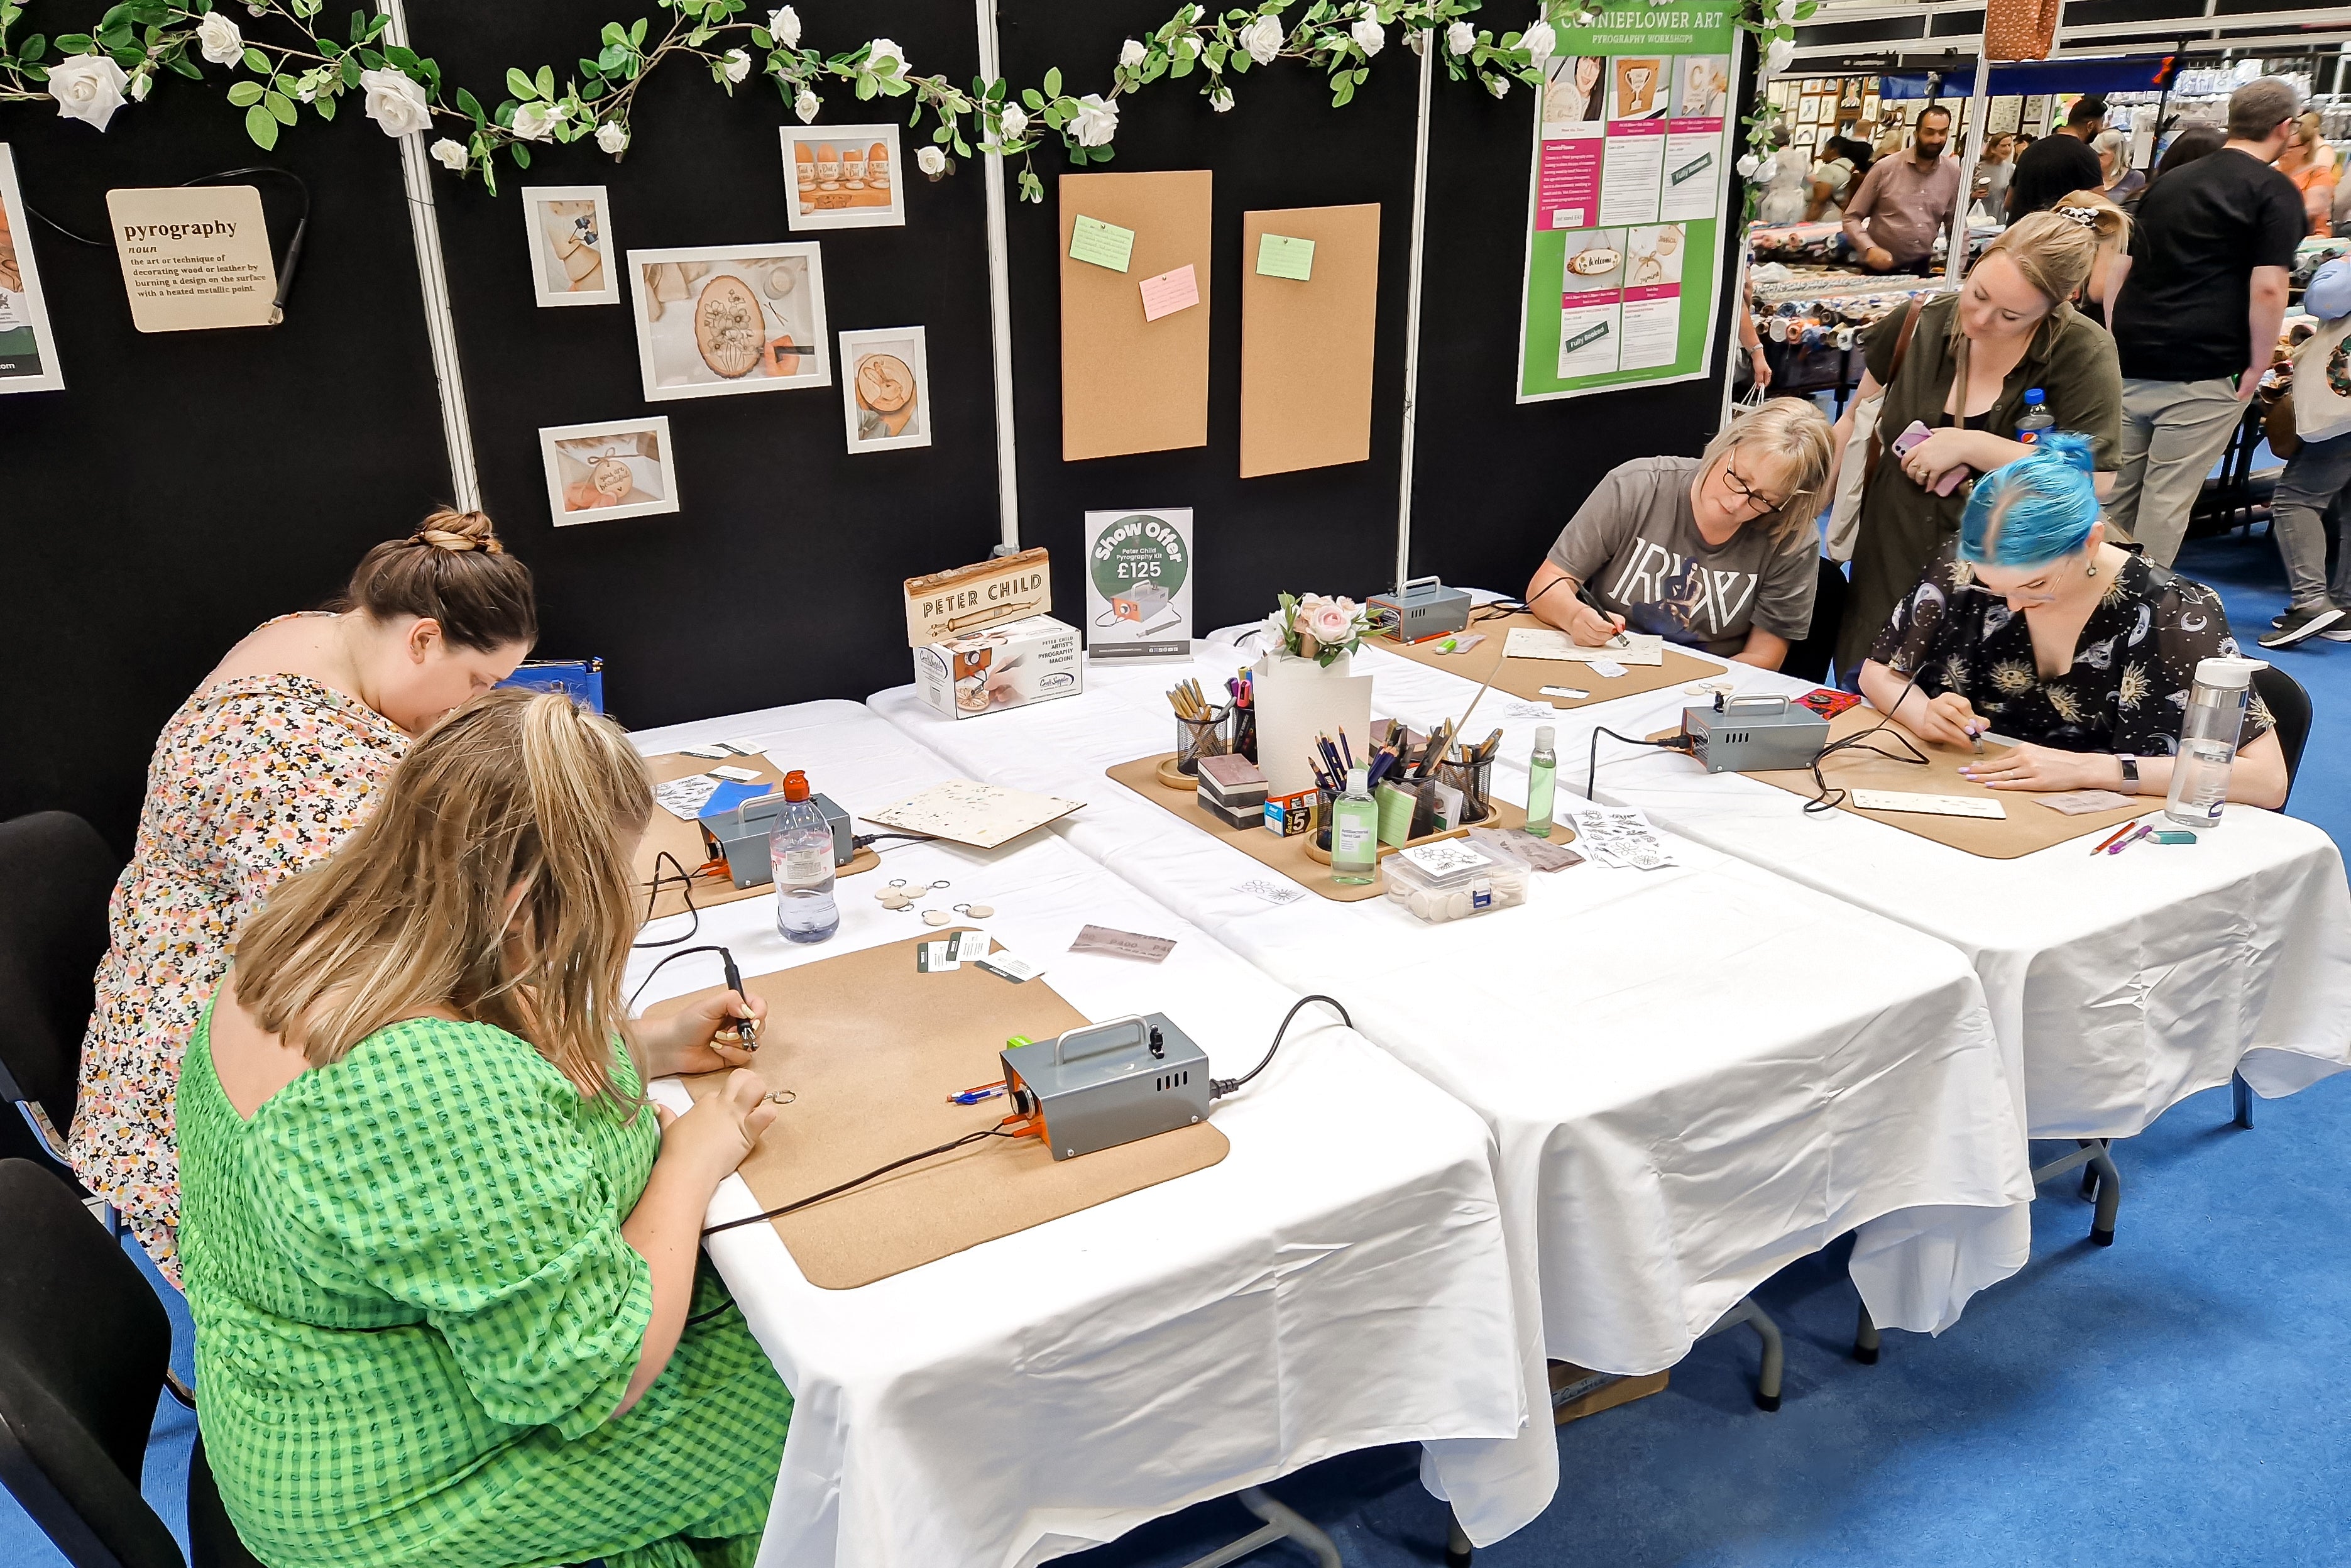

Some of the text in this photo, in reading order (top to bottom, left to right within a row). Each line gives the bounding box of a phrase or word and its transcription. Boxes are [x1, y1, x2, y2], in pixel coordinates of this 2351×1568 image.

[1694, 11, 1724, 29] ART
[1592, 33, 1694, 44] PYROGRAPHY WORKSHOPS
[124, 220, 237, 241] pyrography
[128, 246, 157, 254] noun
[173, 255, 215, 265] technique
[217, 254, 226, 262] of
[1588, 256, 1612, 267] Welcome
[133, 268, 180, 277] decorating
[181, 266, 204, 274] wood
[217, 264, 246, 272] leather
[248, 264, 258, 272] by
[135, 279, 171, 287] burning
[180, 277, 206, 286] design
[236, 274, 266, 282] surface
[137, 289, 157, 297] with
[167, 288, 194, 296] heated
[197, 285, 230, 293] metallic
[1570, 326, 1604, 348] Fully Booked
[1095, 522, 1183, 562] Show Offer
[1117, 561, 1161, 579] £125
[923, 574, 1042, 618] PETER CHILD
[1038, 648, 1073, 659] PYROGRAPHY
[1049, 655, 1073, 664] MACHINE
[1293, 812, 1305, 831] 5
[1109, 938, 1138, 948] P400
